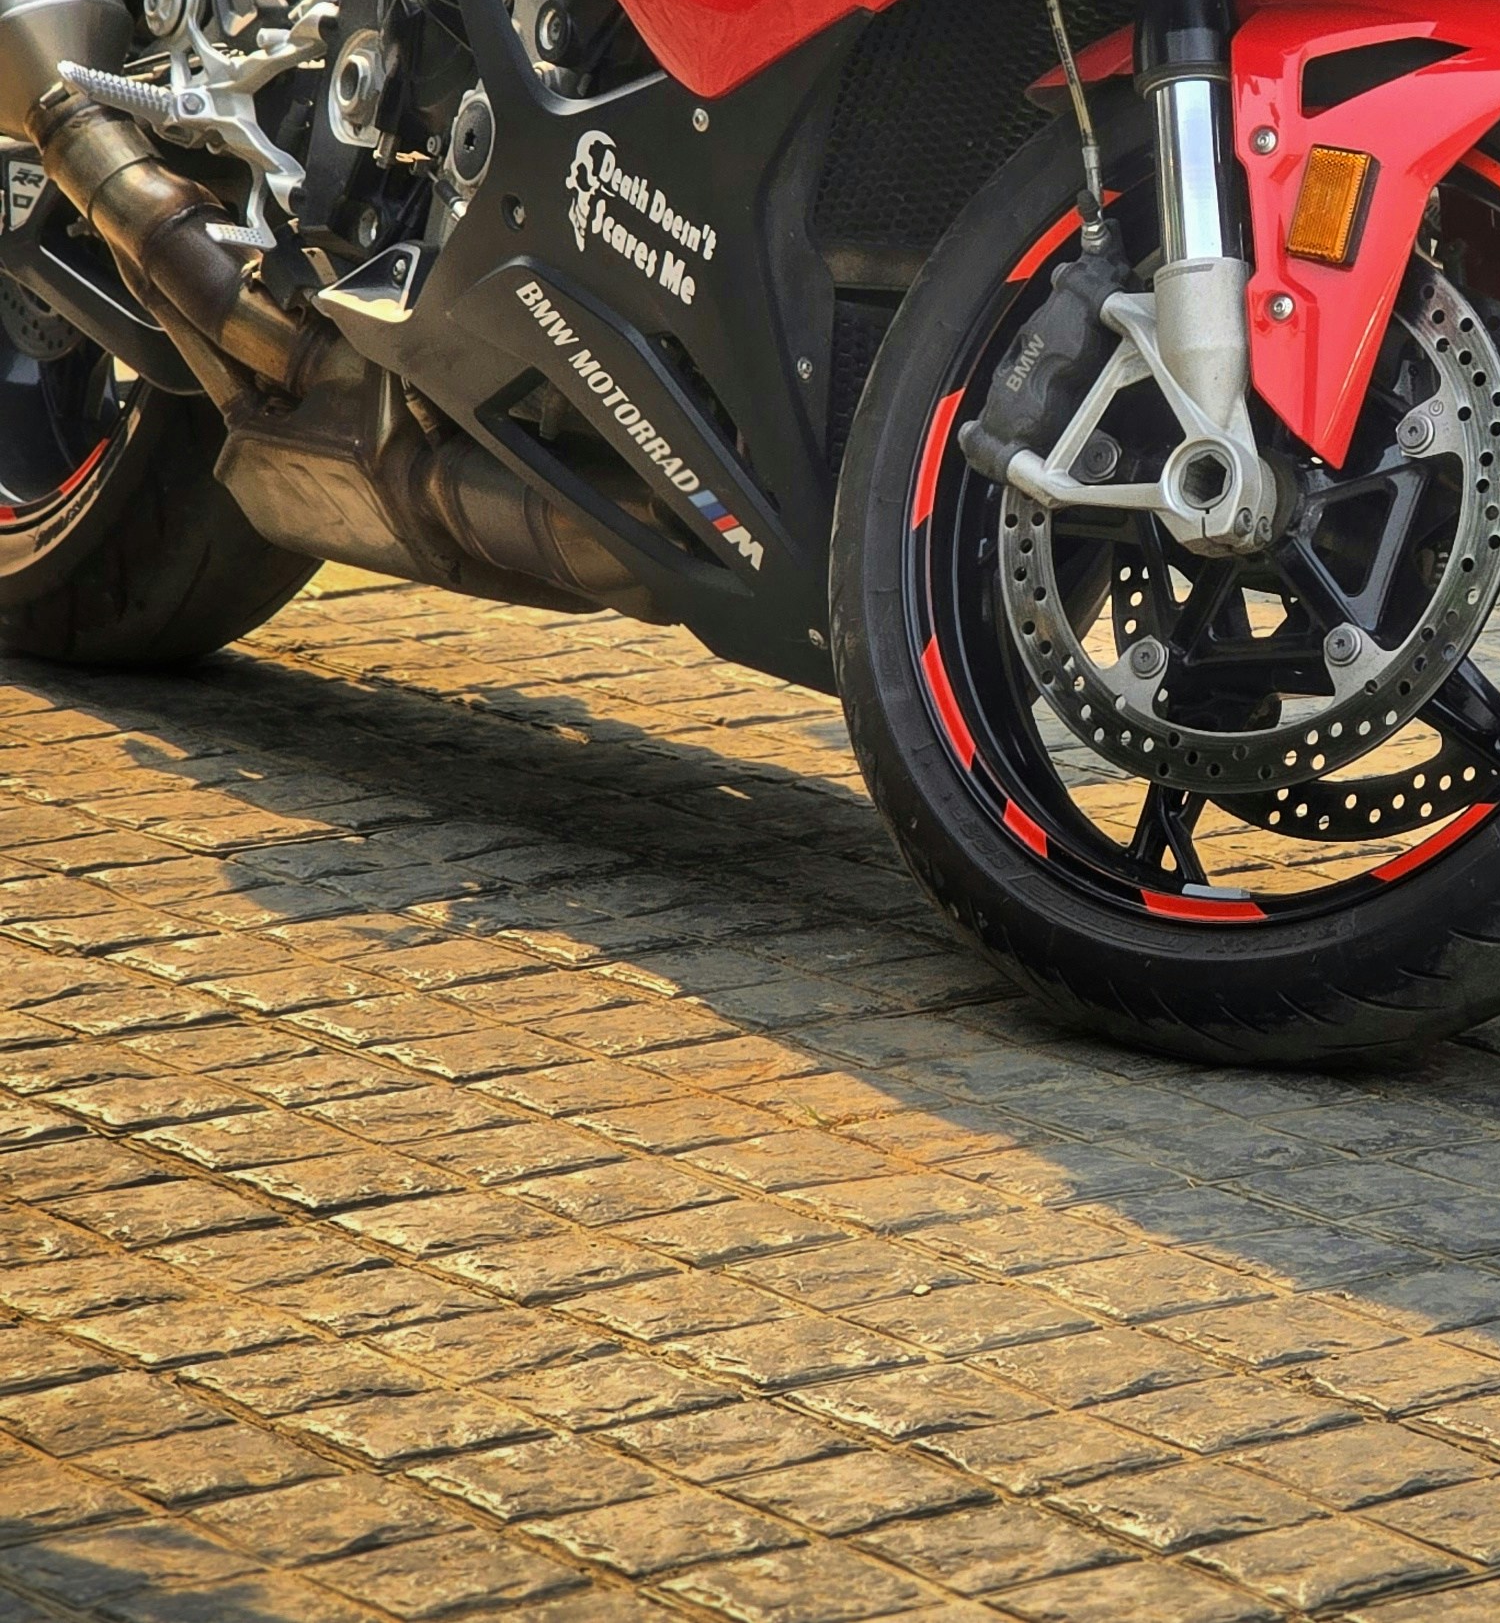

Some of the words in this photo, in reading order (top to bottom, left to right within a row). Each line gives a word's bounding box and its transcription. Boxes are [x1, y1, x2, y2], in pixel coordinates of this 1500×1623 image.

[592, 199, 658, 278] Scares
[659, 250, 696, 305] Me
[599, 149, 649, 213] Death
[649, 189, 717, 261] Doesn't
[1006, 333, 1045, 392] BMW
[516, 281, 579, 346] BMW
[568, 349, 700, 493] MOTORRAD
[722, 526, 764, 571] M
